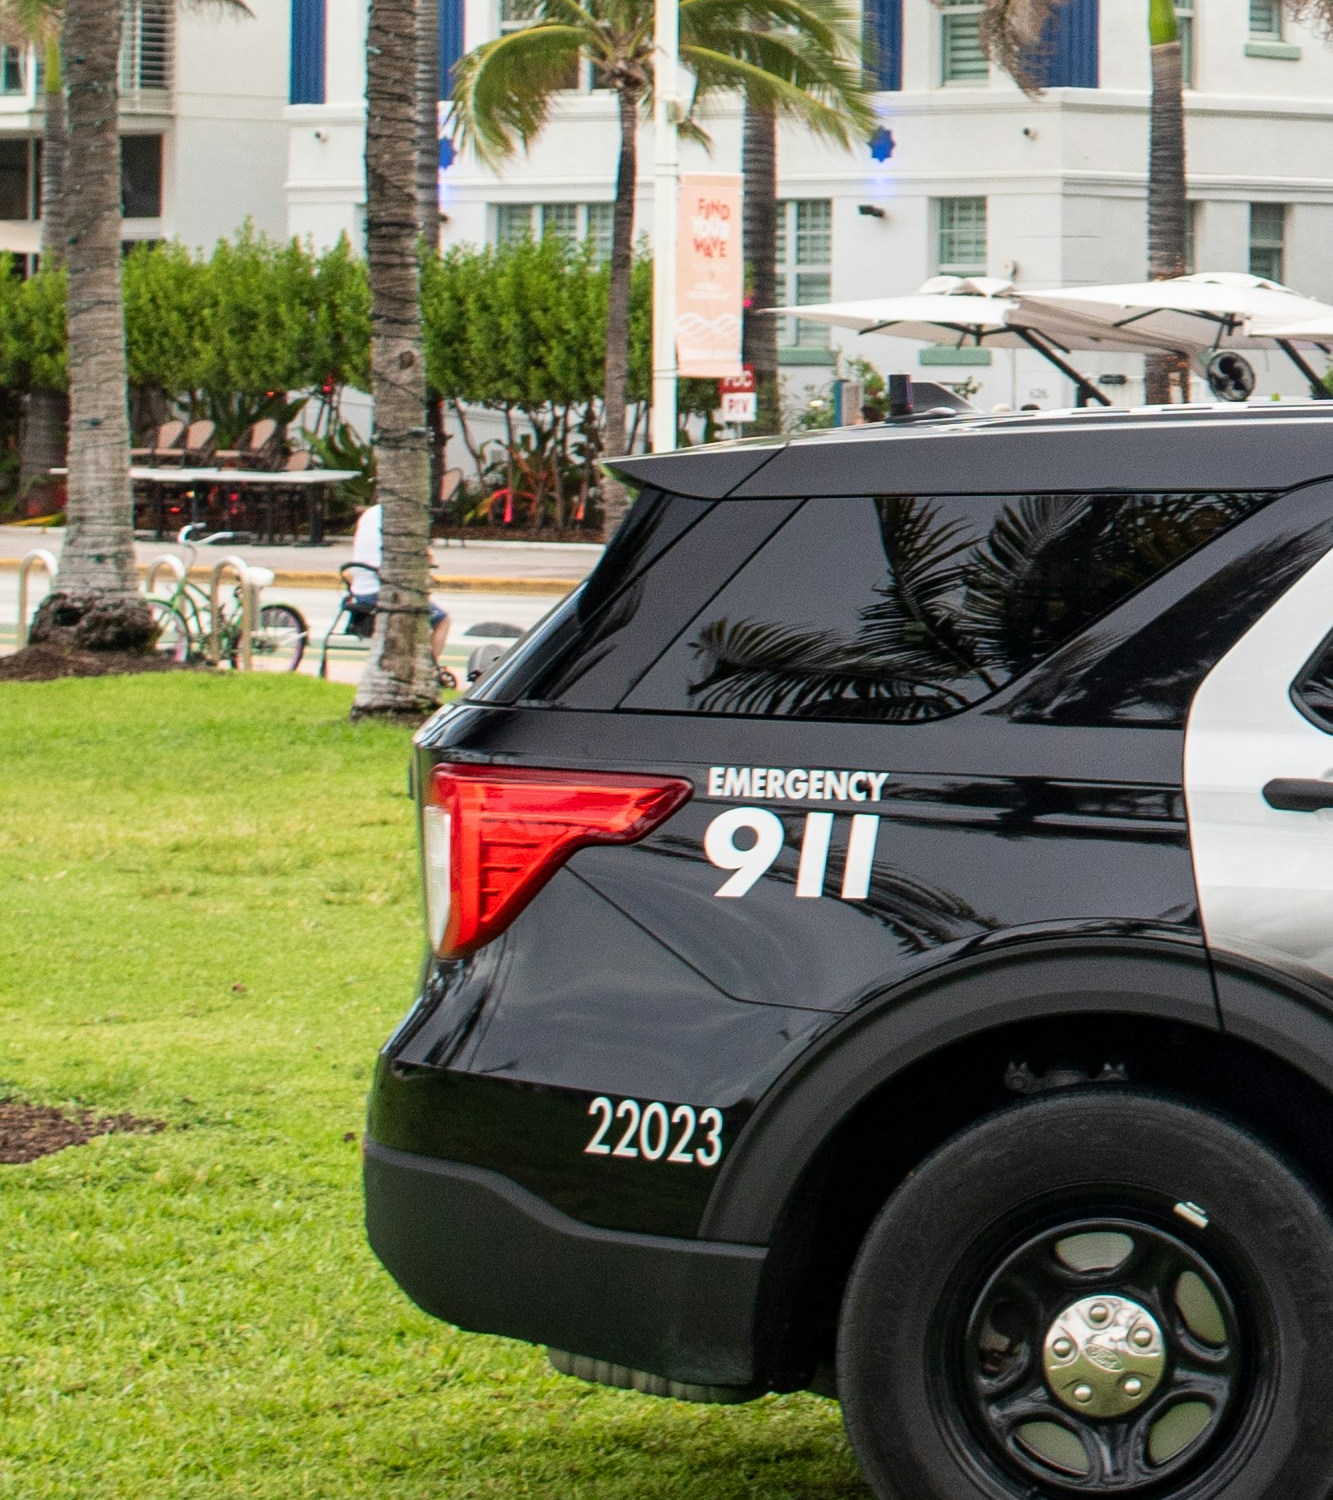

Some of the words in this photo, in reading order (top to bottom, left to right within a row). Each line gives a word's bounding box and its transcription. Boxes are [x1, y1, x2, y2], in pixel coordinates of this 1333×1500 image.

[698, 198, 731, 221] FIND
[693, 237, 727, 258] WAVE
[707, 767, 889, 801] EMERGENCY
[704, 806, 880, 899] 911
[583, 1097, 723, 1167] 22023
